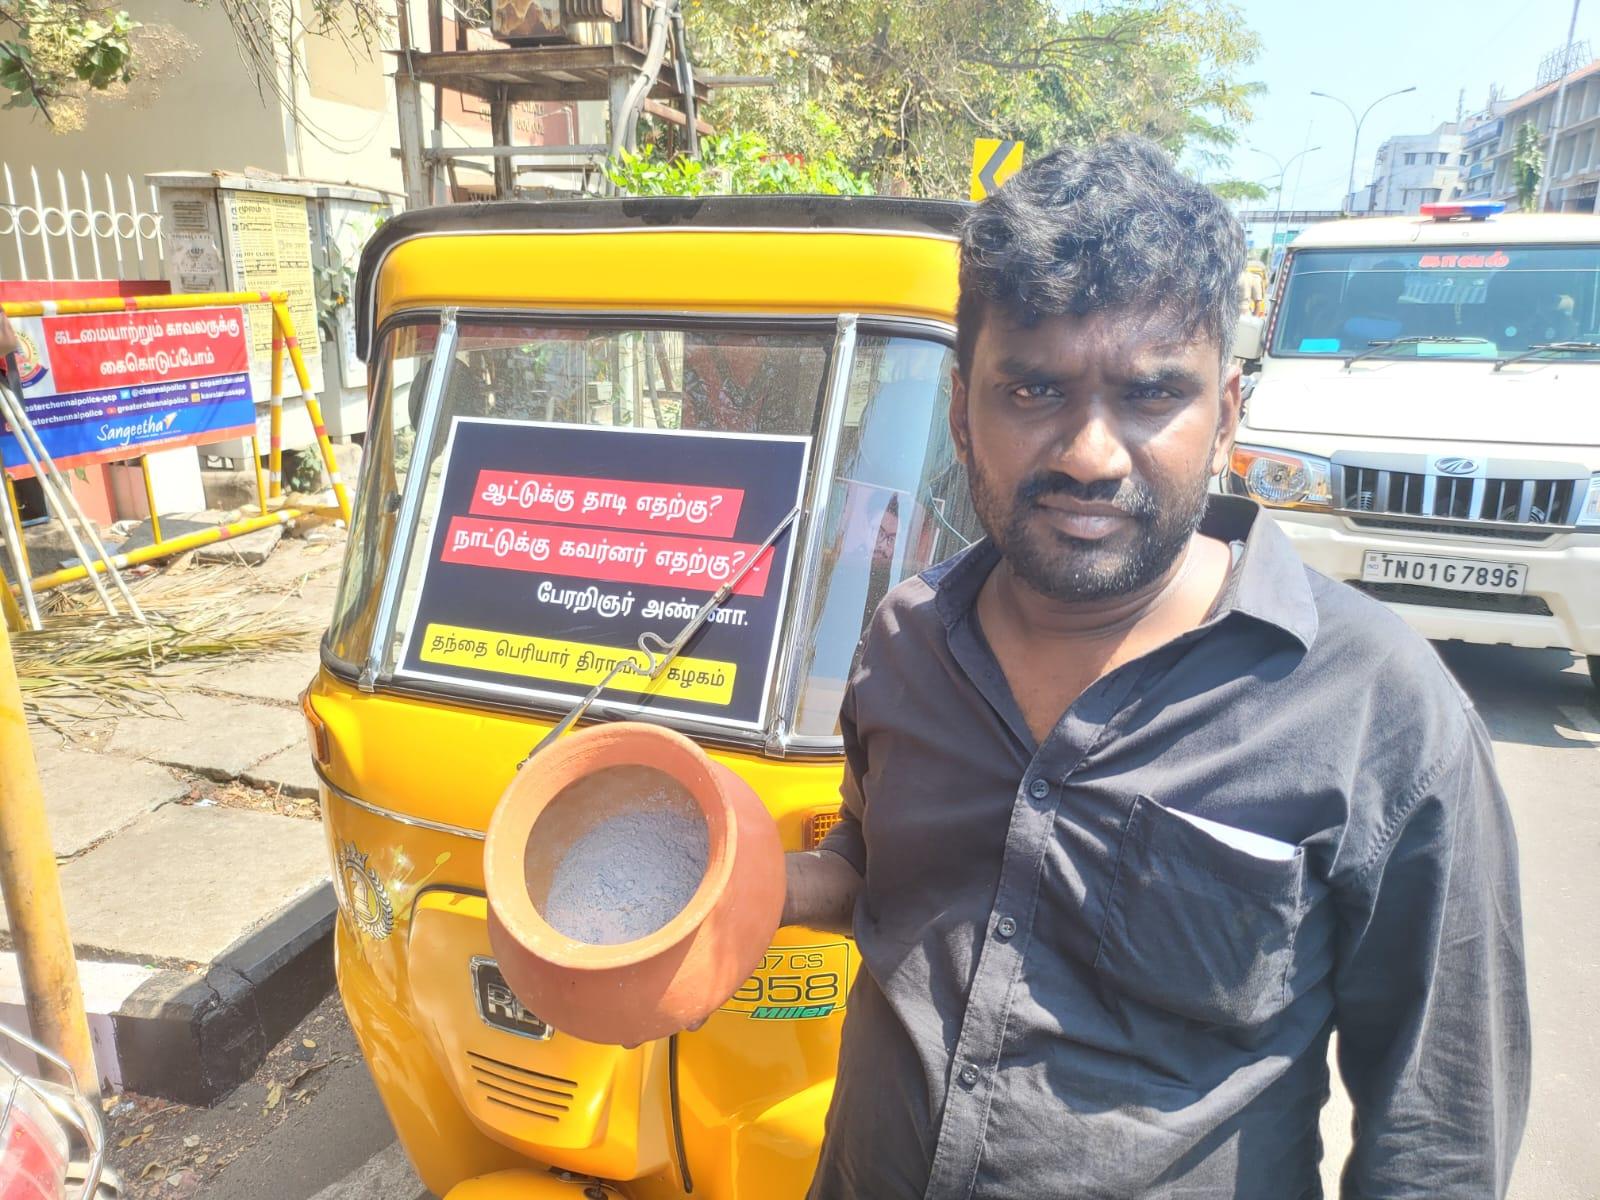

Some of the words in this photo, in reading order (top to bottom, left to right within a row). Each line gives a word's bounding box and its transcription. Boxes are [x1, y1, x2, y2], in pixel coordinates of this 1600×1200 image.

[1419, 250, 1510, 268] காவல்
[54, 319, 163, 346] கடமையாற்றும்
[166, 314, 240, 339] காவலருக்கு
[100, 347, 215, 375] கைகொடுப்போம்
[96, 412, 163, 446] Sangeetha
[482, 479, 575, 508] ஆட்டுக்கு
[582, 489, 628, 515] தாடி
[636, 495, 722, 524] எதற்கு?
[452, 526, 551, 562] நாட்டுக்கு
[559, 538, 648, 566] கவர்னர்
[655, 547, 745, 580] எதற்கு?
[1382, 559, 1519, 588] TN01G7896
[537, 580, 635, 617] பேரறிஞர்
[431, 632, 488, 657] தந்தை
[495, 639, 571, 670] பெரியார்
[576, 649, 657, 677] திராவி
[667, 668, 725, 689] கழகம்
[790, 953, 823, 970] CS
[752, 1003, 836, 1019] Miller
